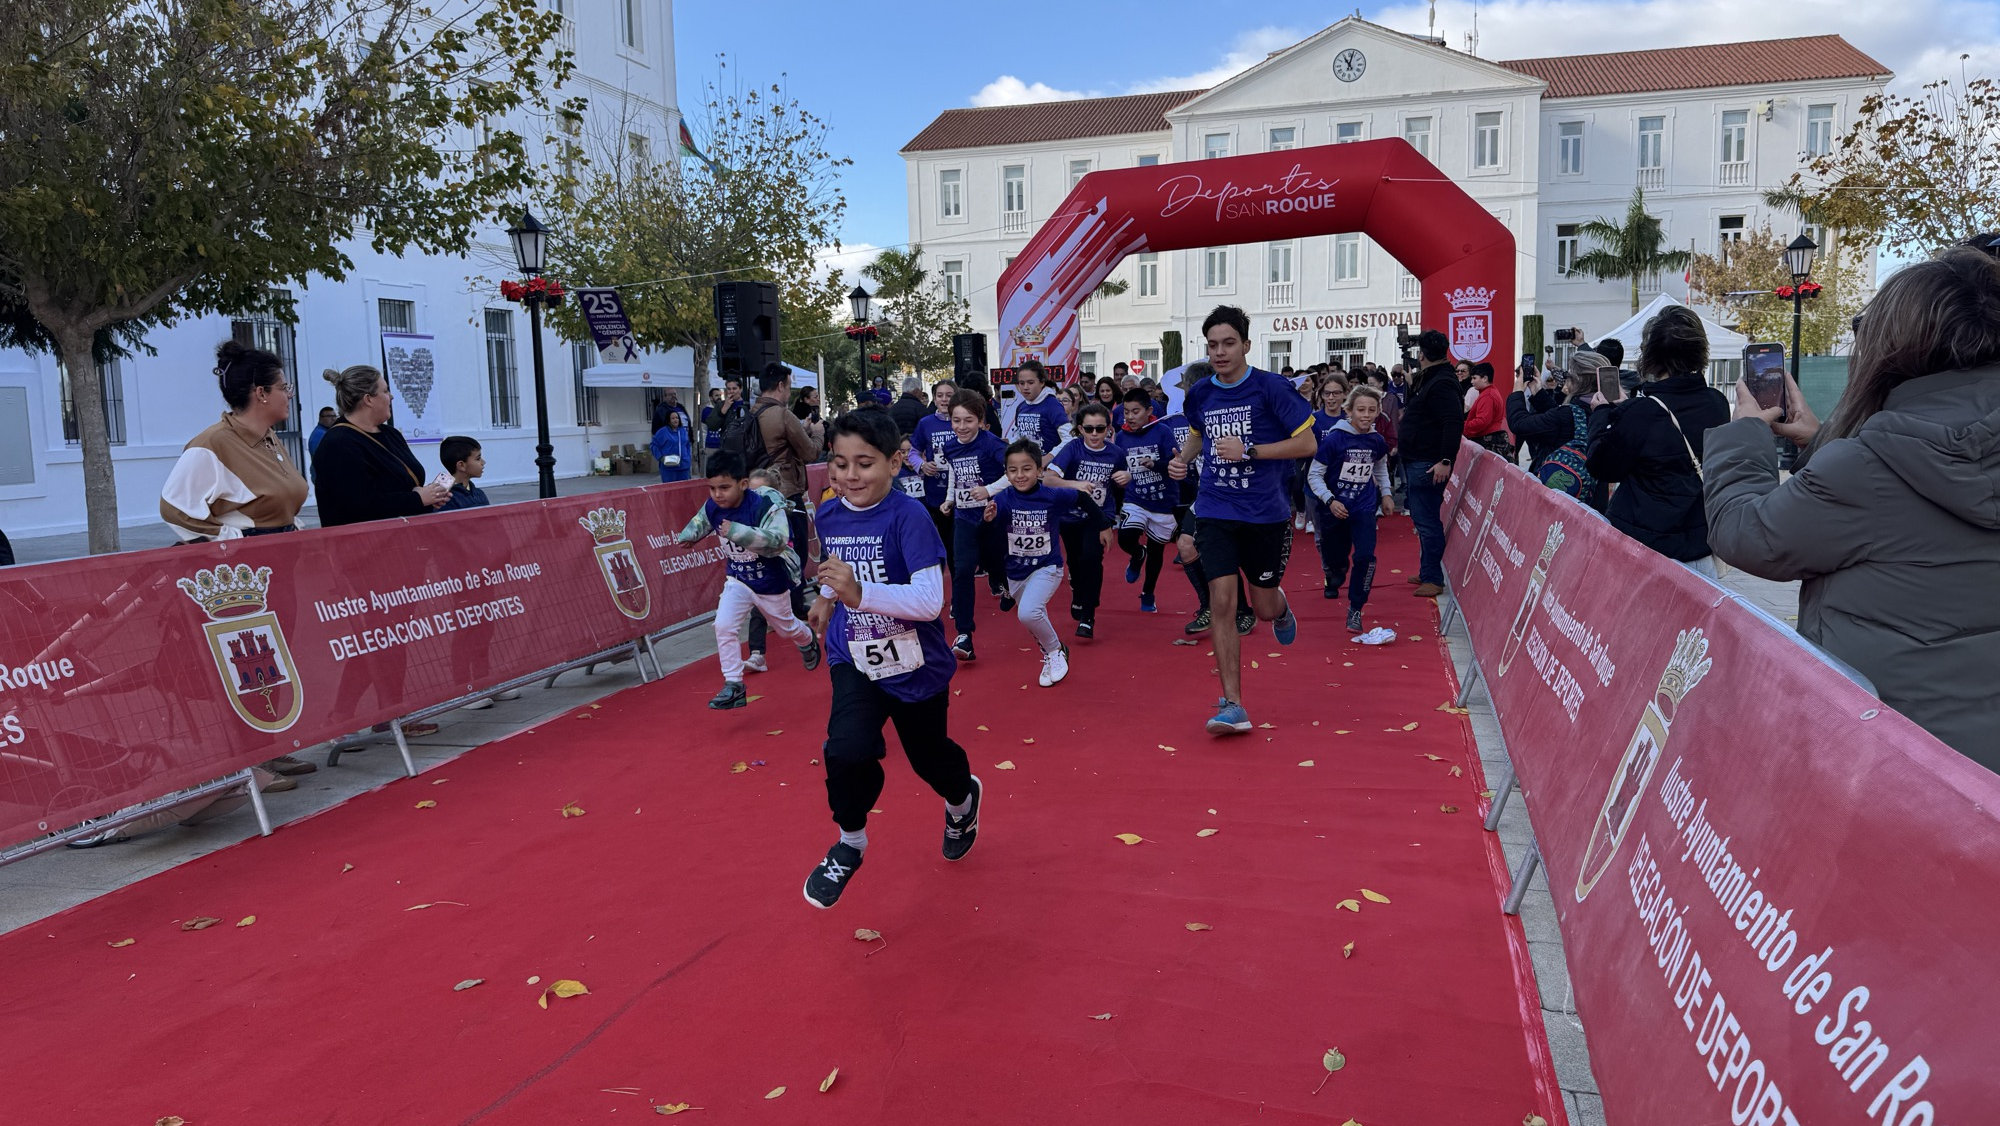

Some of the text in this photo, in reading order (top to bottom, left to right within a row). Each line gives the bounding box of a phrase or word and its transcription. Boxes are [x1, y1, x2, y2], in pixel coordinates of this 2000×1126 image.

[1157, 163, 1340, 222] Deportes
[584, 294, 618, 314] 25
[1273, 312, 1421, 332] CASA CONSISTORIAL
[1204, 411, 1252, 426] SAN ROQUE
[1206, 421, 1252, 439] CORRE
[1078, 464, 1113, 475] SAN ROQUE
[1347, 465, 1371, 476] 412
[846, 546, 883, 560] ROQUE
[1014, 536, 1045, 549] 428
[314, 562, 542, 623] Ilustre Ayuntamiento de San Roque
[329, 596, 525, 661] DELEGACIÓN DE DEPORTES
[1581, 626, 1593, 656] de
[866, 640, 900, 665] 51
[0, 658, 75, 692] Roque
[1542, 654, 1560, 686] DE
[1552, 664, 1585, 724] DEPORTES
[1628, 831, 1691, 989] DELEGACIÓN
[1674, 950, 1712, 1033] DE
[1660, 755, 1693, 830] Ilustre
[1681, 798, 1798, 972] Ayuntamiento
[1782, 946, 1834, 1015] de
[1814, 986, 1890, 1094] San
